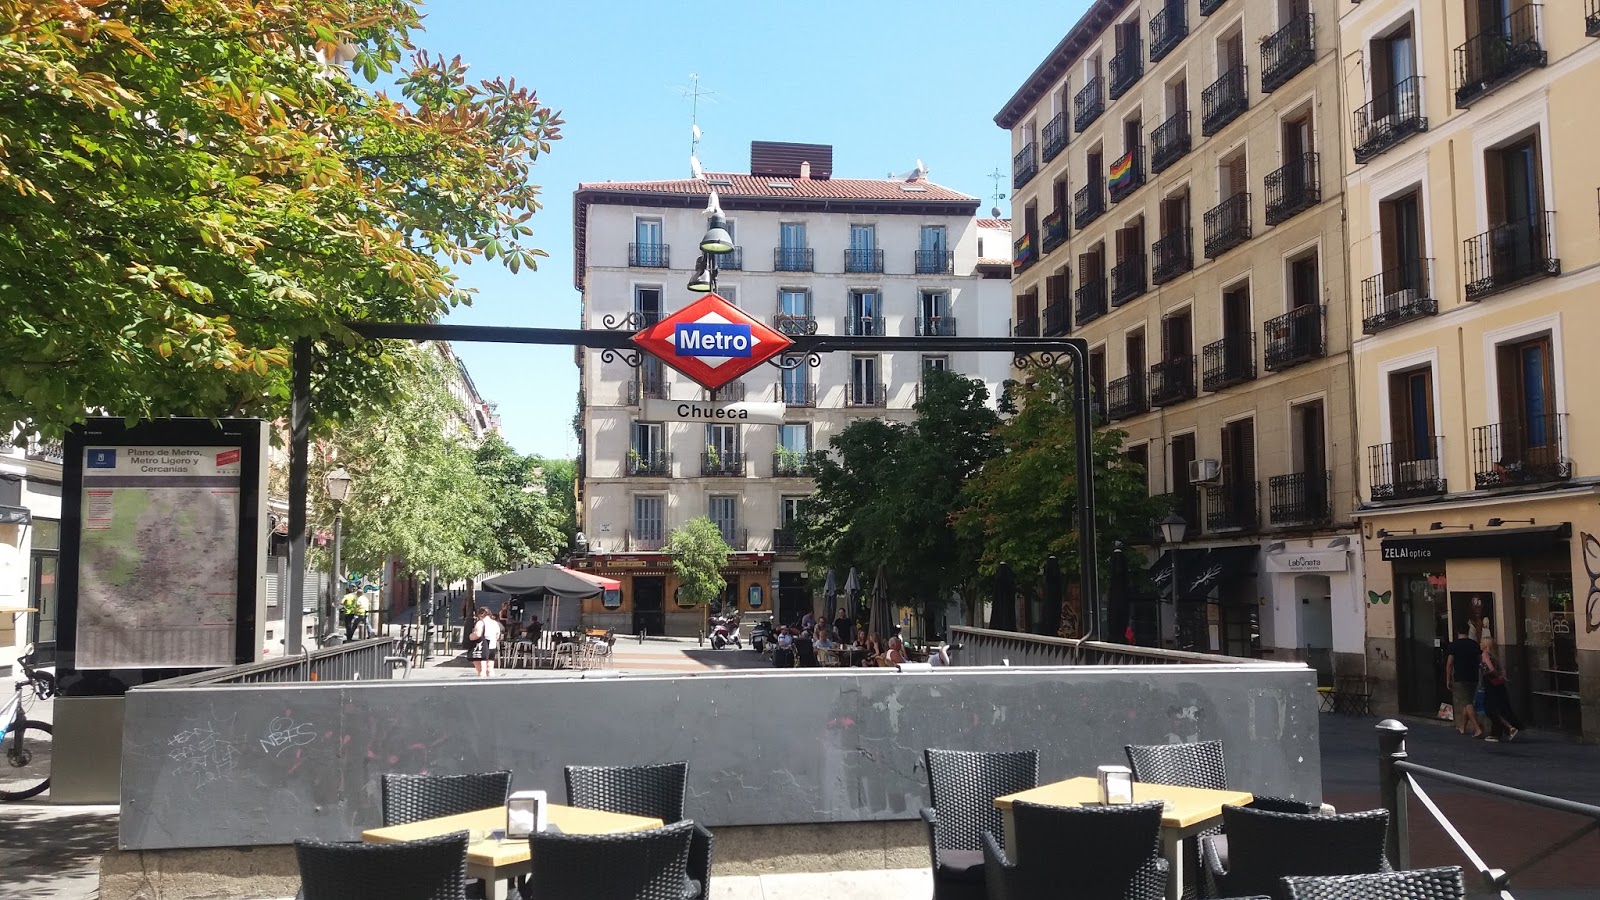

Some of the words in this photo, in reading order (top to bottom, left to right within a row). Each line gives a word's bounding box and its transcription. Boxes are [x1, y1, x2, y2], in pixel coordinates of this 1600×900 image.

[680, 330, 748, 350] Metro
[677, 404, 748, 419] Chueca
[127, 448, 155, 456] Plano
[157, 448, 170, 456] de
[161, 457, 191, 466] Ligero
[1384, 548, 1408, 558] ZELAI
